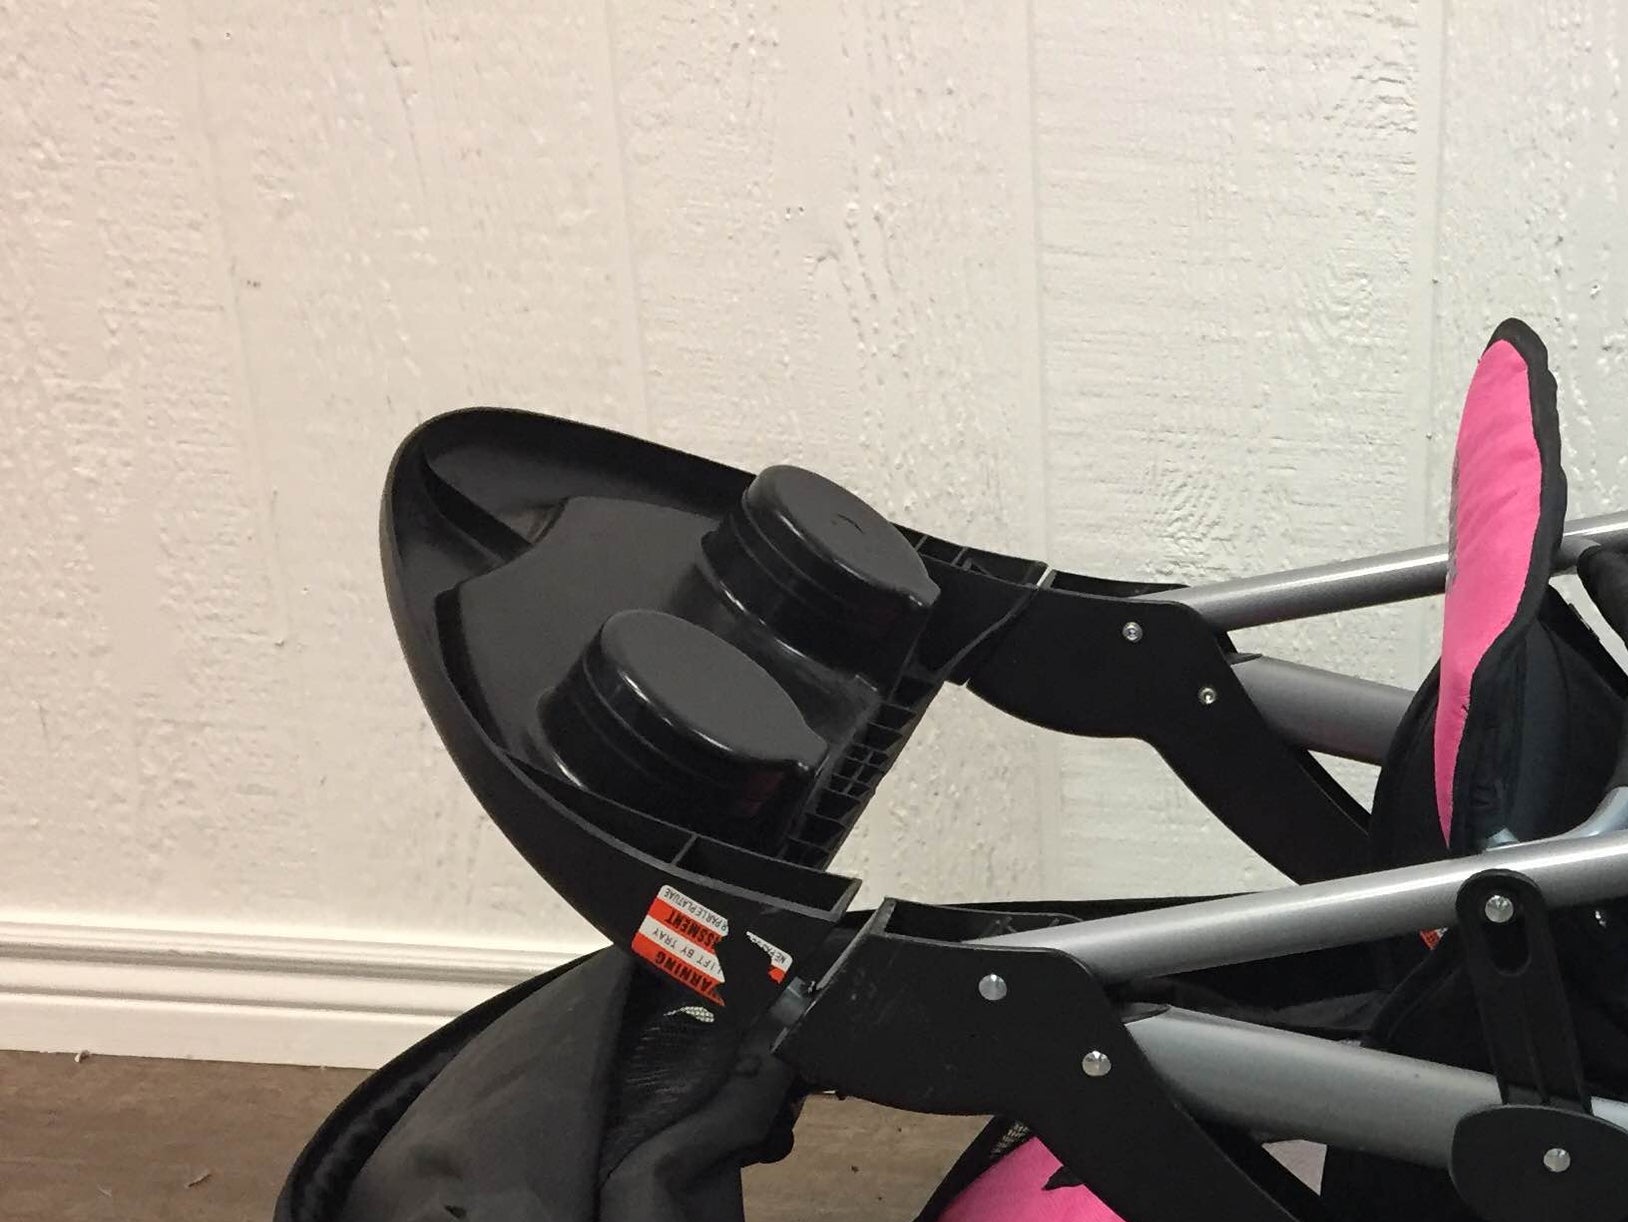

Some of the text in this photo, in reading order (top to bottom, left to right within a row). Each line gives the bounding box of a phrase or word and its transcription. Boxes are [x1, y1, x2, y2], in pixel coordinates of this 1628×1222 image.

[652, 928, 676, 950] TRAY
[680, 946, 695, 959] BY
[655, 951, 717, 998] ARNING
